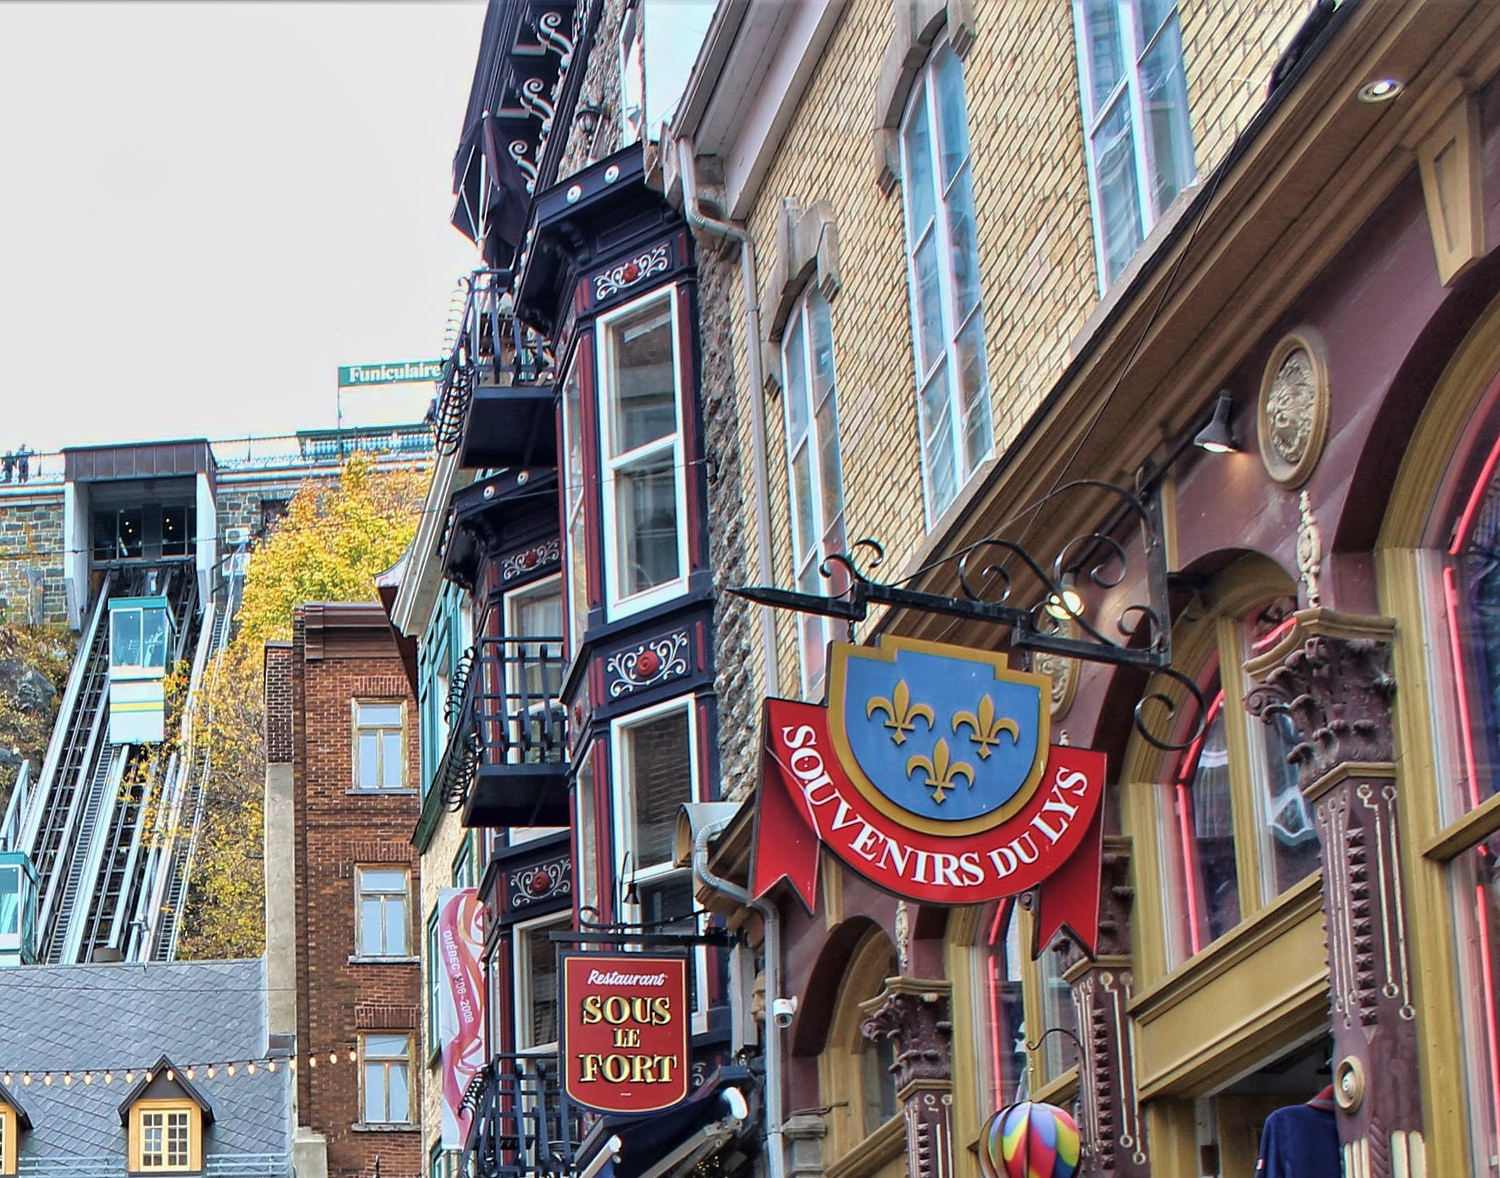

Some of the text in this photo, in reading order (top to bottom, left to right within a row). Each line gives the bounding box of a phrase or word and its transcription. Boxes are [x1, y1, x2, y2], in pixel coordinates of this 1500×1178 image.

[349, 362, 441, 383] Funiculaire
[781, 724, 1089, 887] SOUVENIRS DU LYS
[443, 930, 461, 971] QUÉBEC
[587, 969, 666, 986] Restaurant
[581, 995, 672, 1025] SOUS
[612, 1028, 641, 1048] LE
[577, 1054, 678, 1083] FORT
